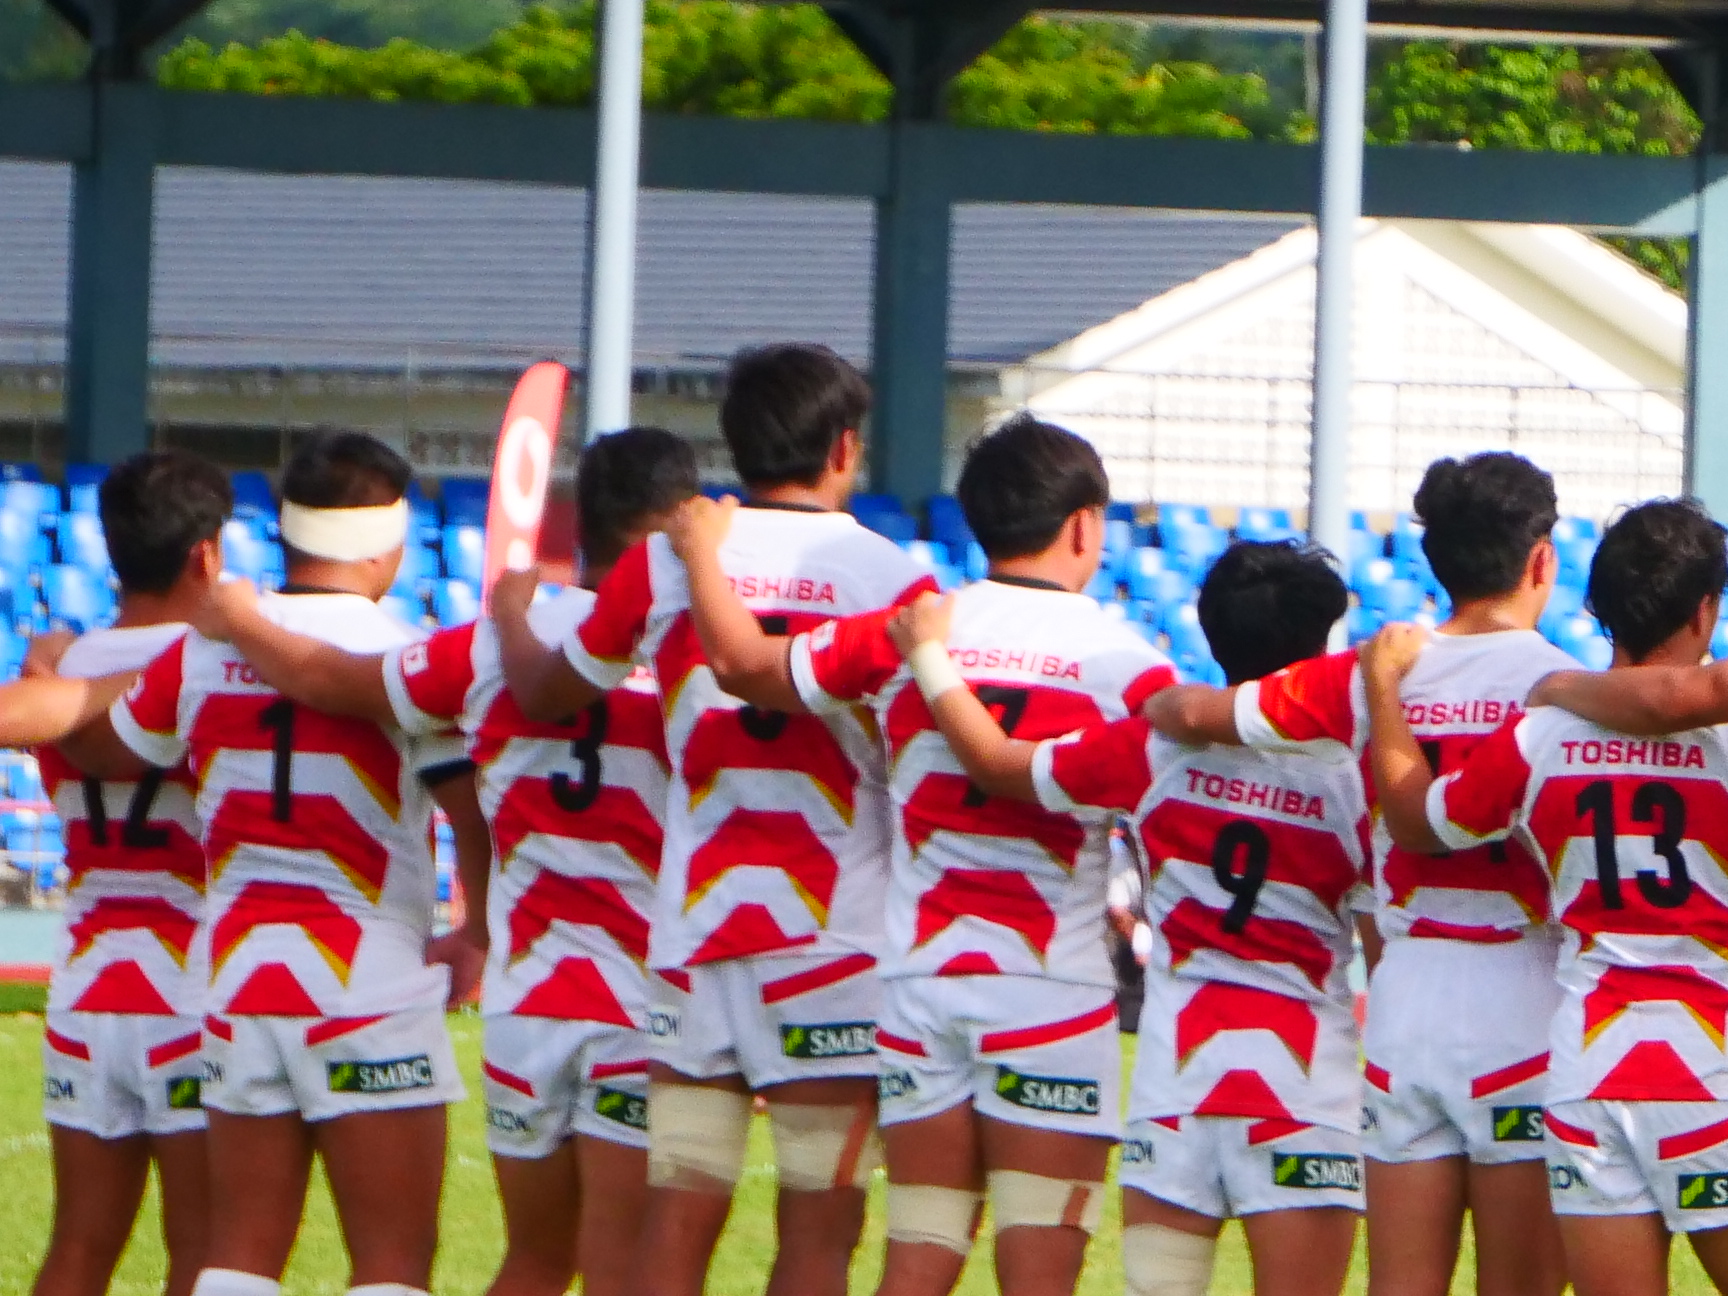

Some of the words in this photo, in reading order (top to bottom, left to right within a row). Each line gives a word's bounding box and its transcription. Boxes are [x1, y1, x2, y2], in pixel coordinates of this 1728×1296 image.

[728, 575, 835, 604] SHIBA
[260, 698, 293, 823] 1
[551, 702, 608, 813] 3
[1561, 739, 1706, 769] TOSHIBA
[1186, 767, 1325, 820] TOSHIBA
[1575, 780, 1692, 910] 13
[1212, 820, 1270, 934] 9
[360, 1059, 432, 1091] SMBC
[1020, 1079, 1098, 1113] SMBC
